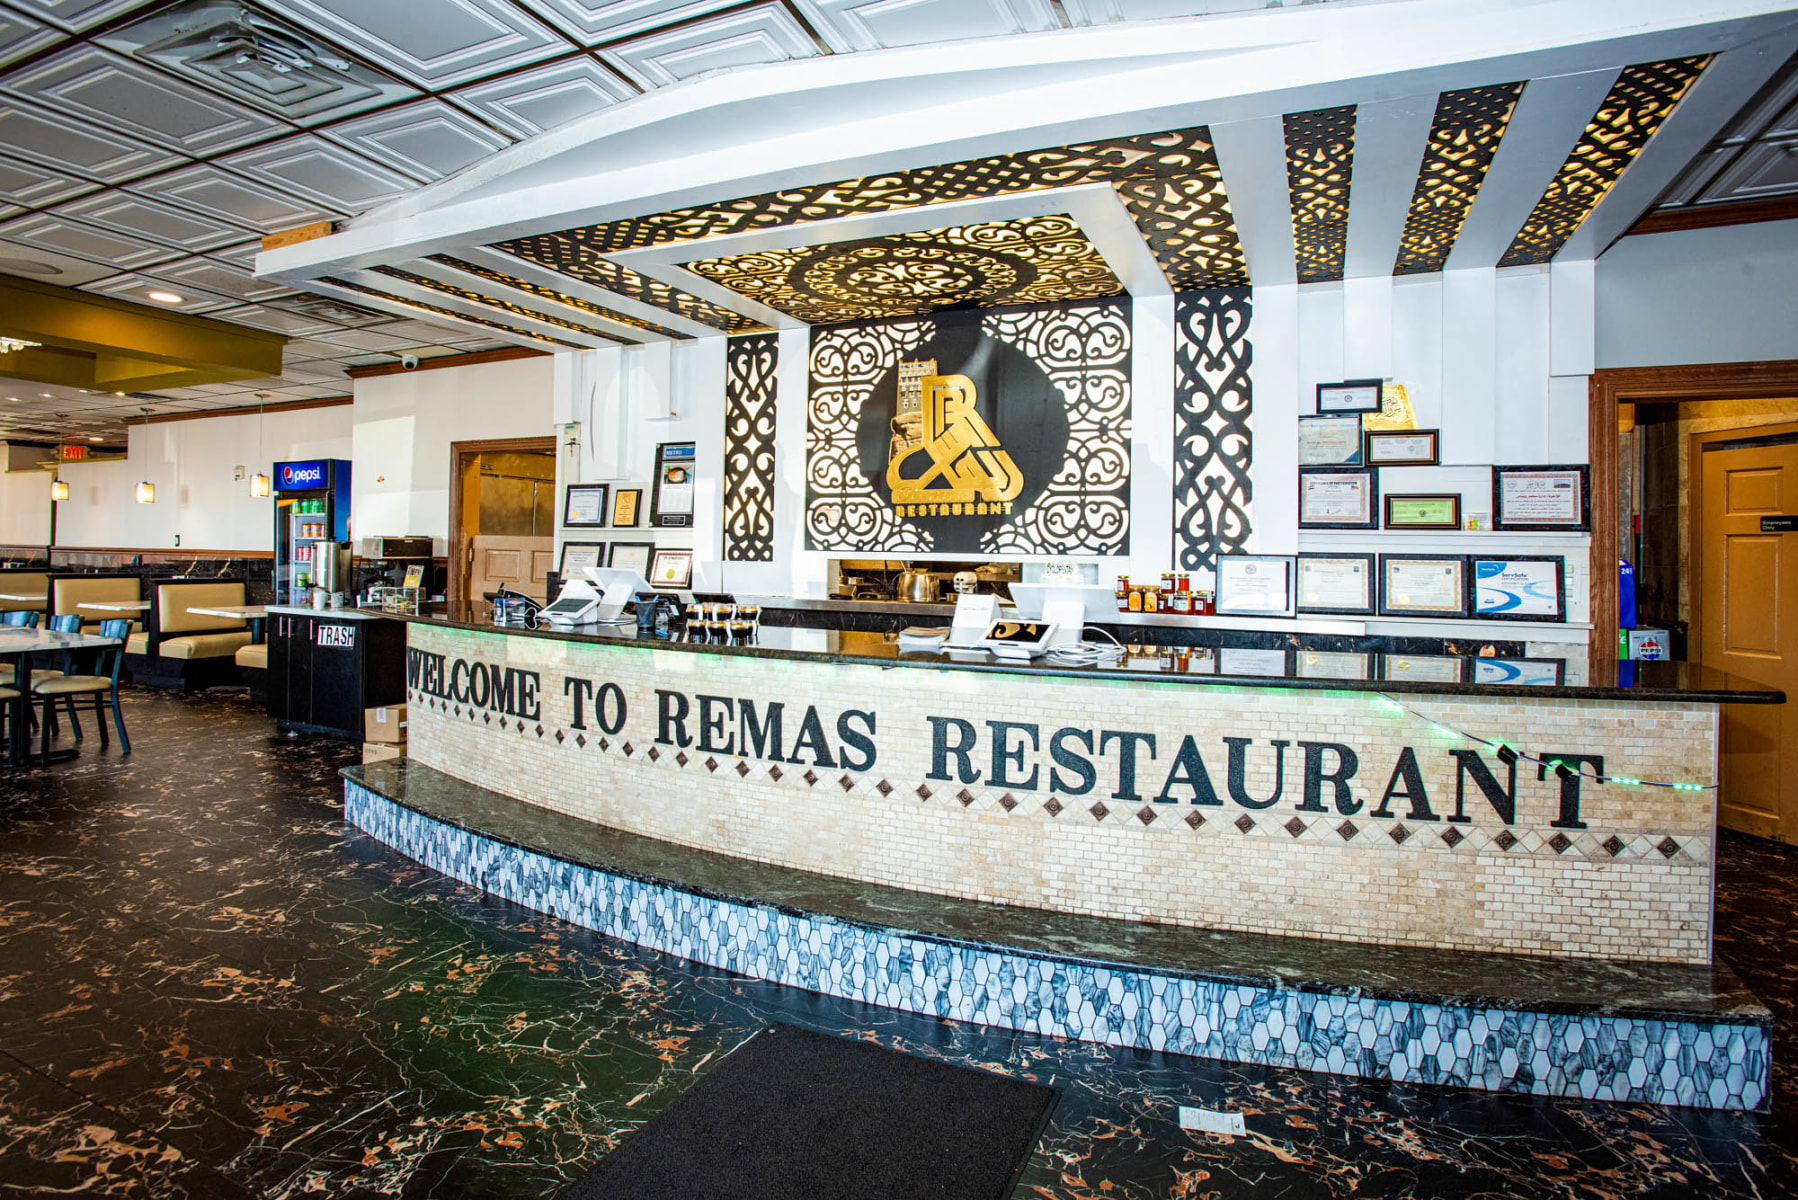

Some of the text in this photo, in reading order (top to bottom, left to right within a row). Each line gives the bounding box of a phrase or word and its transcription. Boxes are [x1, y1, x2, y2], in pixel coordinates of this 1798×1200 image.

[63, 446, 83, 459] EXIT
[294, 467, 321, 483] pepsi
[895, 502, 1013, 517] RESTAURANT
[319, 626, 354, 645] TRASH
[407, 647, 1604, 829] WELCOME TO REMAS RESTAURANT
